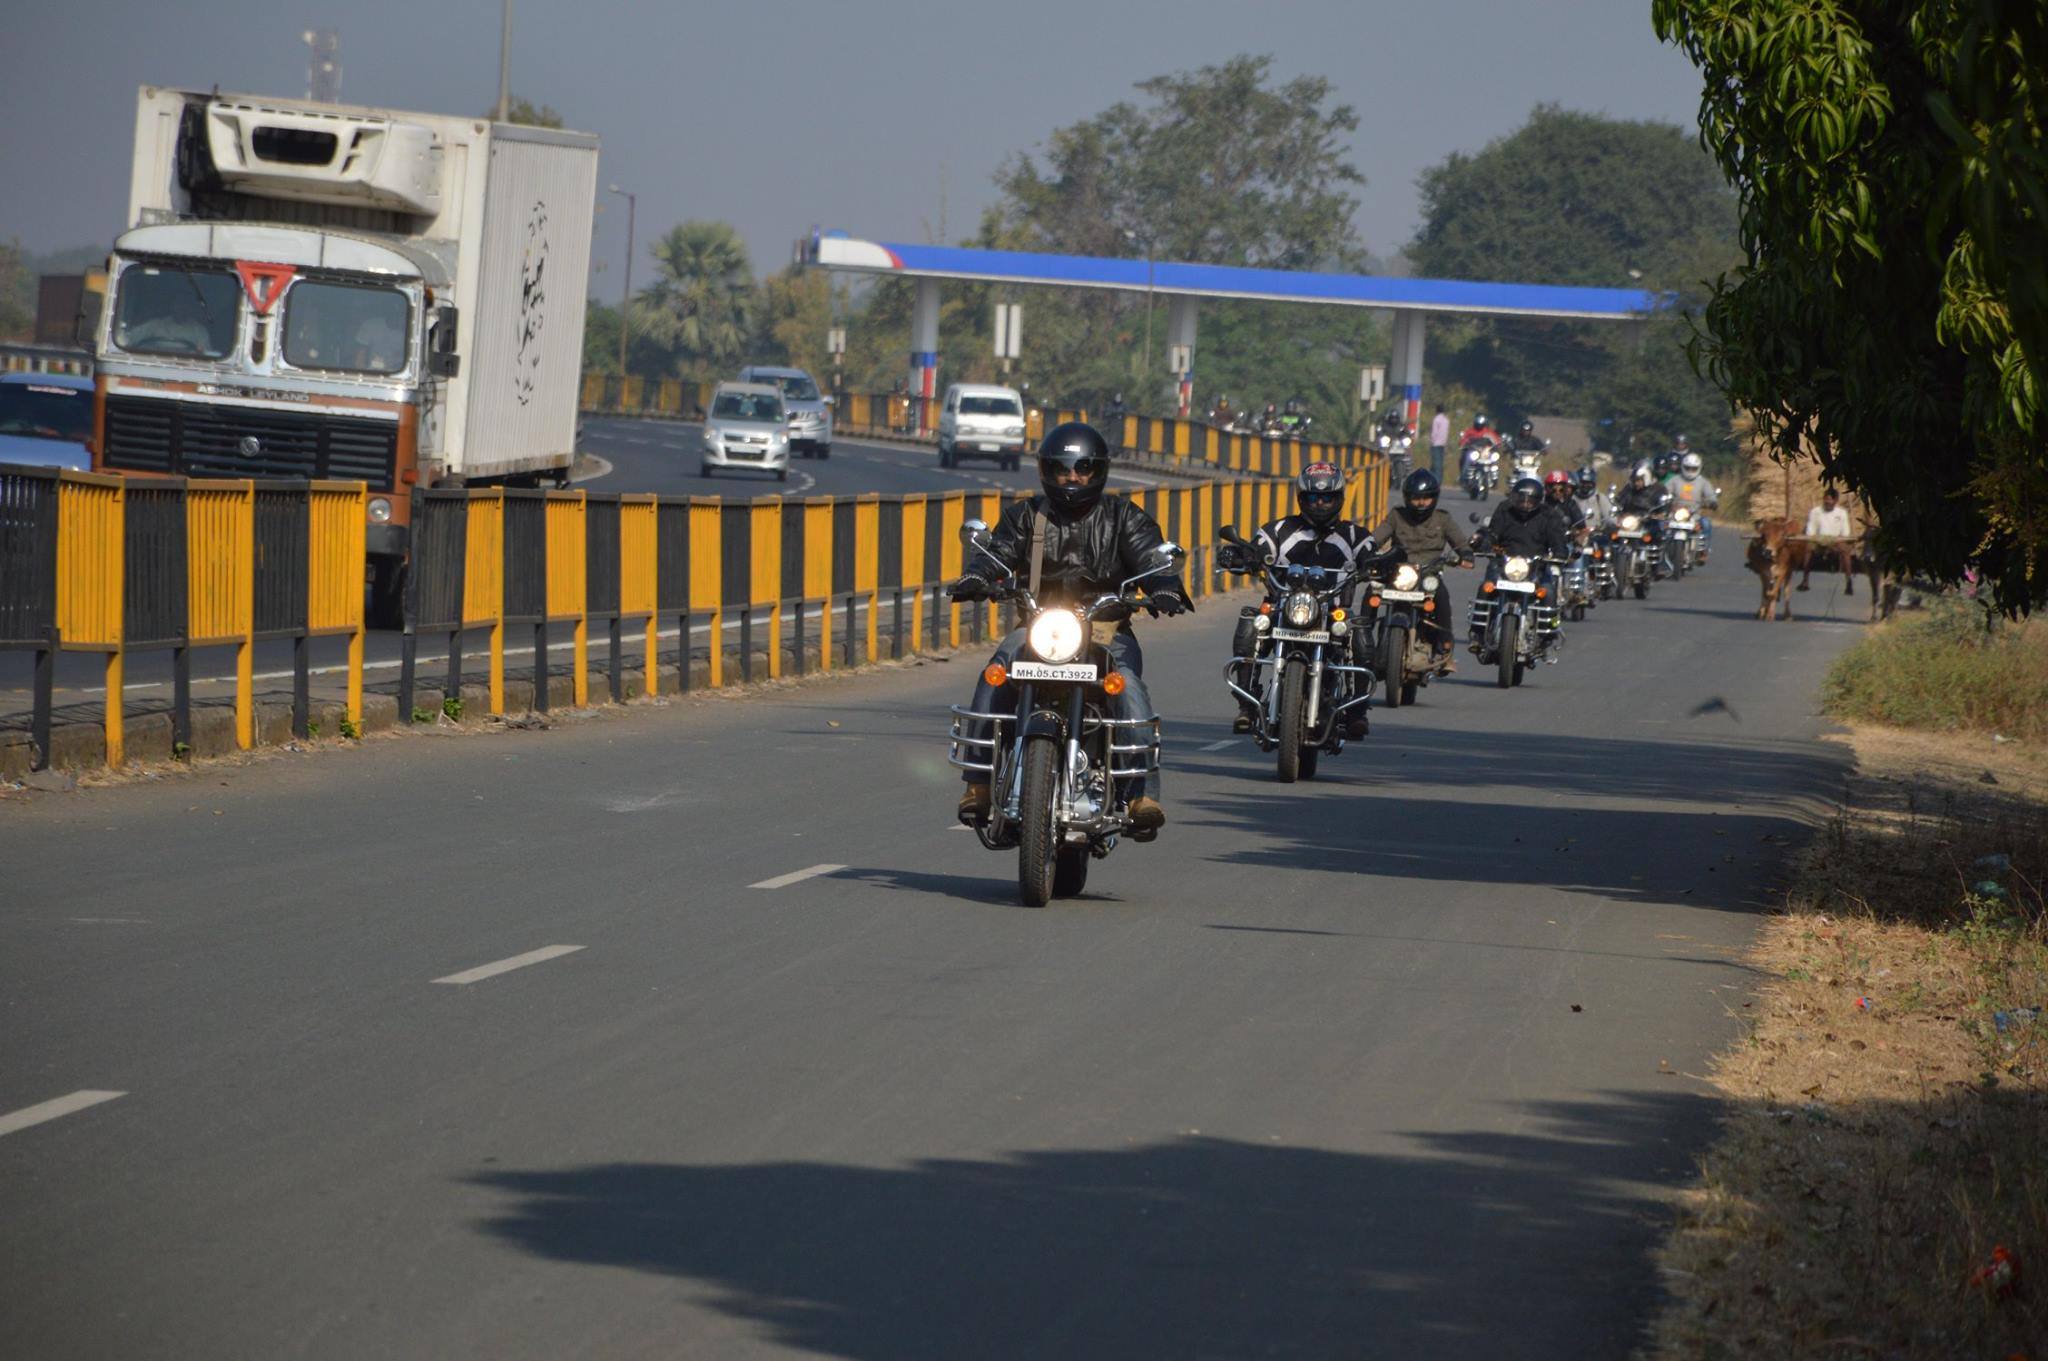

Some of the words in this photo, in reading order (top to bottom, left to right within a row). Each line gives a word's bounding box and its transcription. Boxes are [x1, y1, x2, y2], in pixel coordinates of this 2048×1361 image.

[197, 384, 242, 398] ASHOK
[250, 388, 310, 401] LEYLAND
[1016, 669, 1094, 680] MH.05.CT.3922
